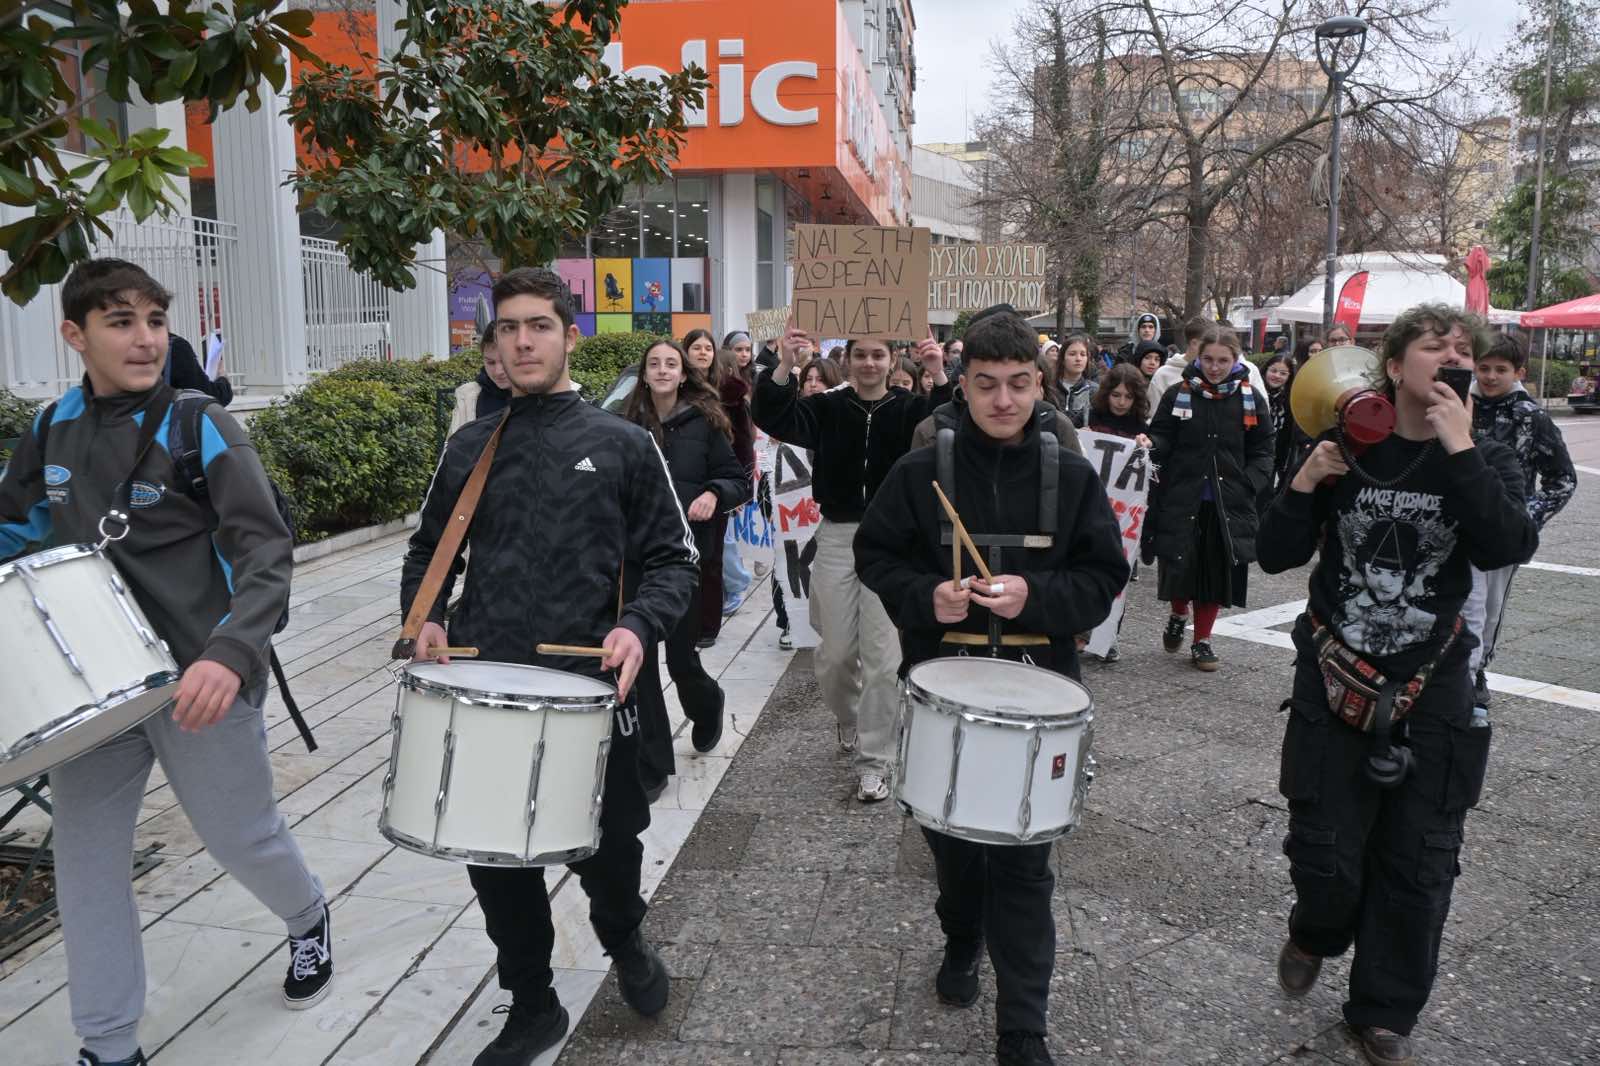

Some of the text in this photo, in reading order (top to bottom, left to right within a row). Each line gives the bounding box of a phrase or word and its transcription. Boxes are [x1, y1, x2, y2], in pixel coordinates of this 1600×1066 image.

[798, 228, 914, 259] ΝΑΙ ΣΤΗ
[984, 245, 1046, 277] ΣΧΟΛΕΙΟ
[796, 297, 914, 336] ΠΑΙΔΕΙΑ
